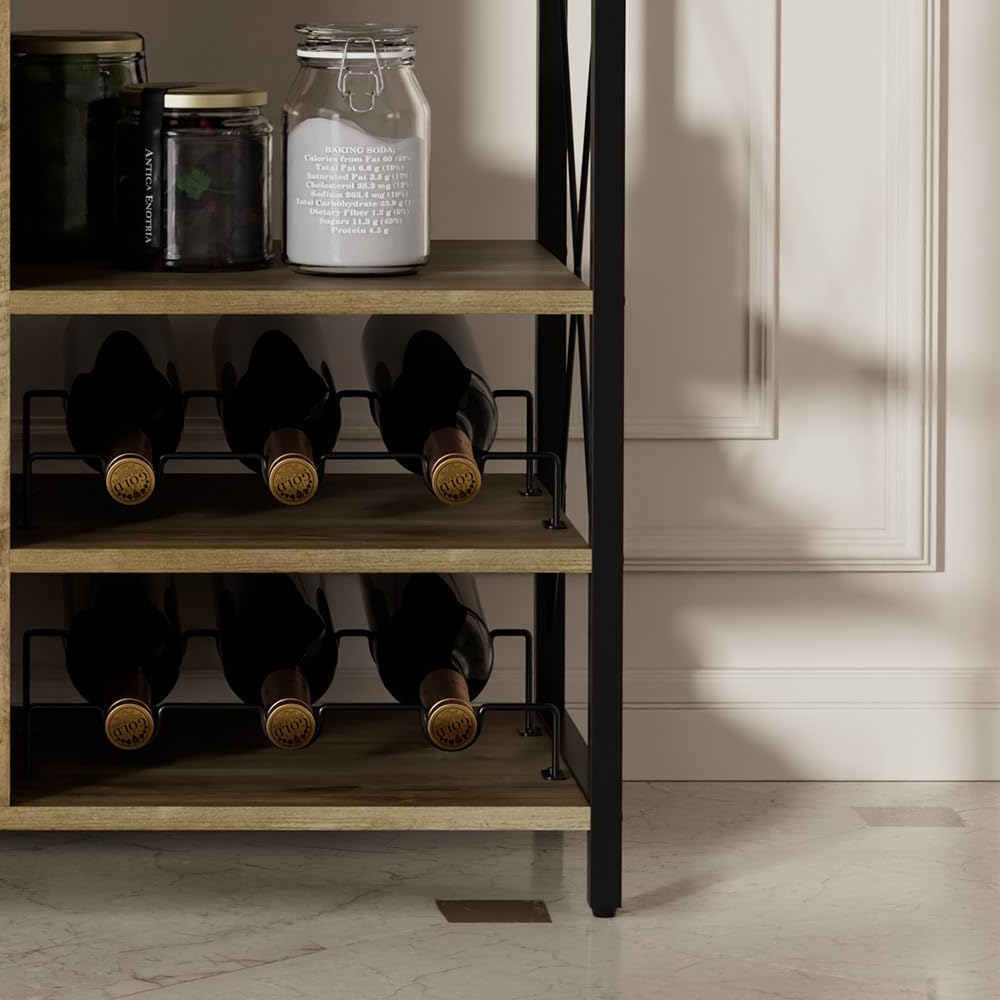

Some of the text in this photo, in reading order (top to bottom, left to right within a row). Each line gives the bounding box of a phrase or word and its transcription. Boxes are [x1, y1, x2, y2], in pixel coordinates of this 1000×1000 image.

[325, 146, 364, 154] BAKING
[144, 148, 154, 191] ANTICA
[144, 194, 154, 244] ENOTRIA
[113, 471, 148, 493] GOLD
[276, 471, 312, 493] GOLD
[440, 471, 474, 493] GOLD
[113, 717, 147, 738] GOLD
[274, 717, 308, 738] GOLD
[435, 717, 471, 738] GOLD
